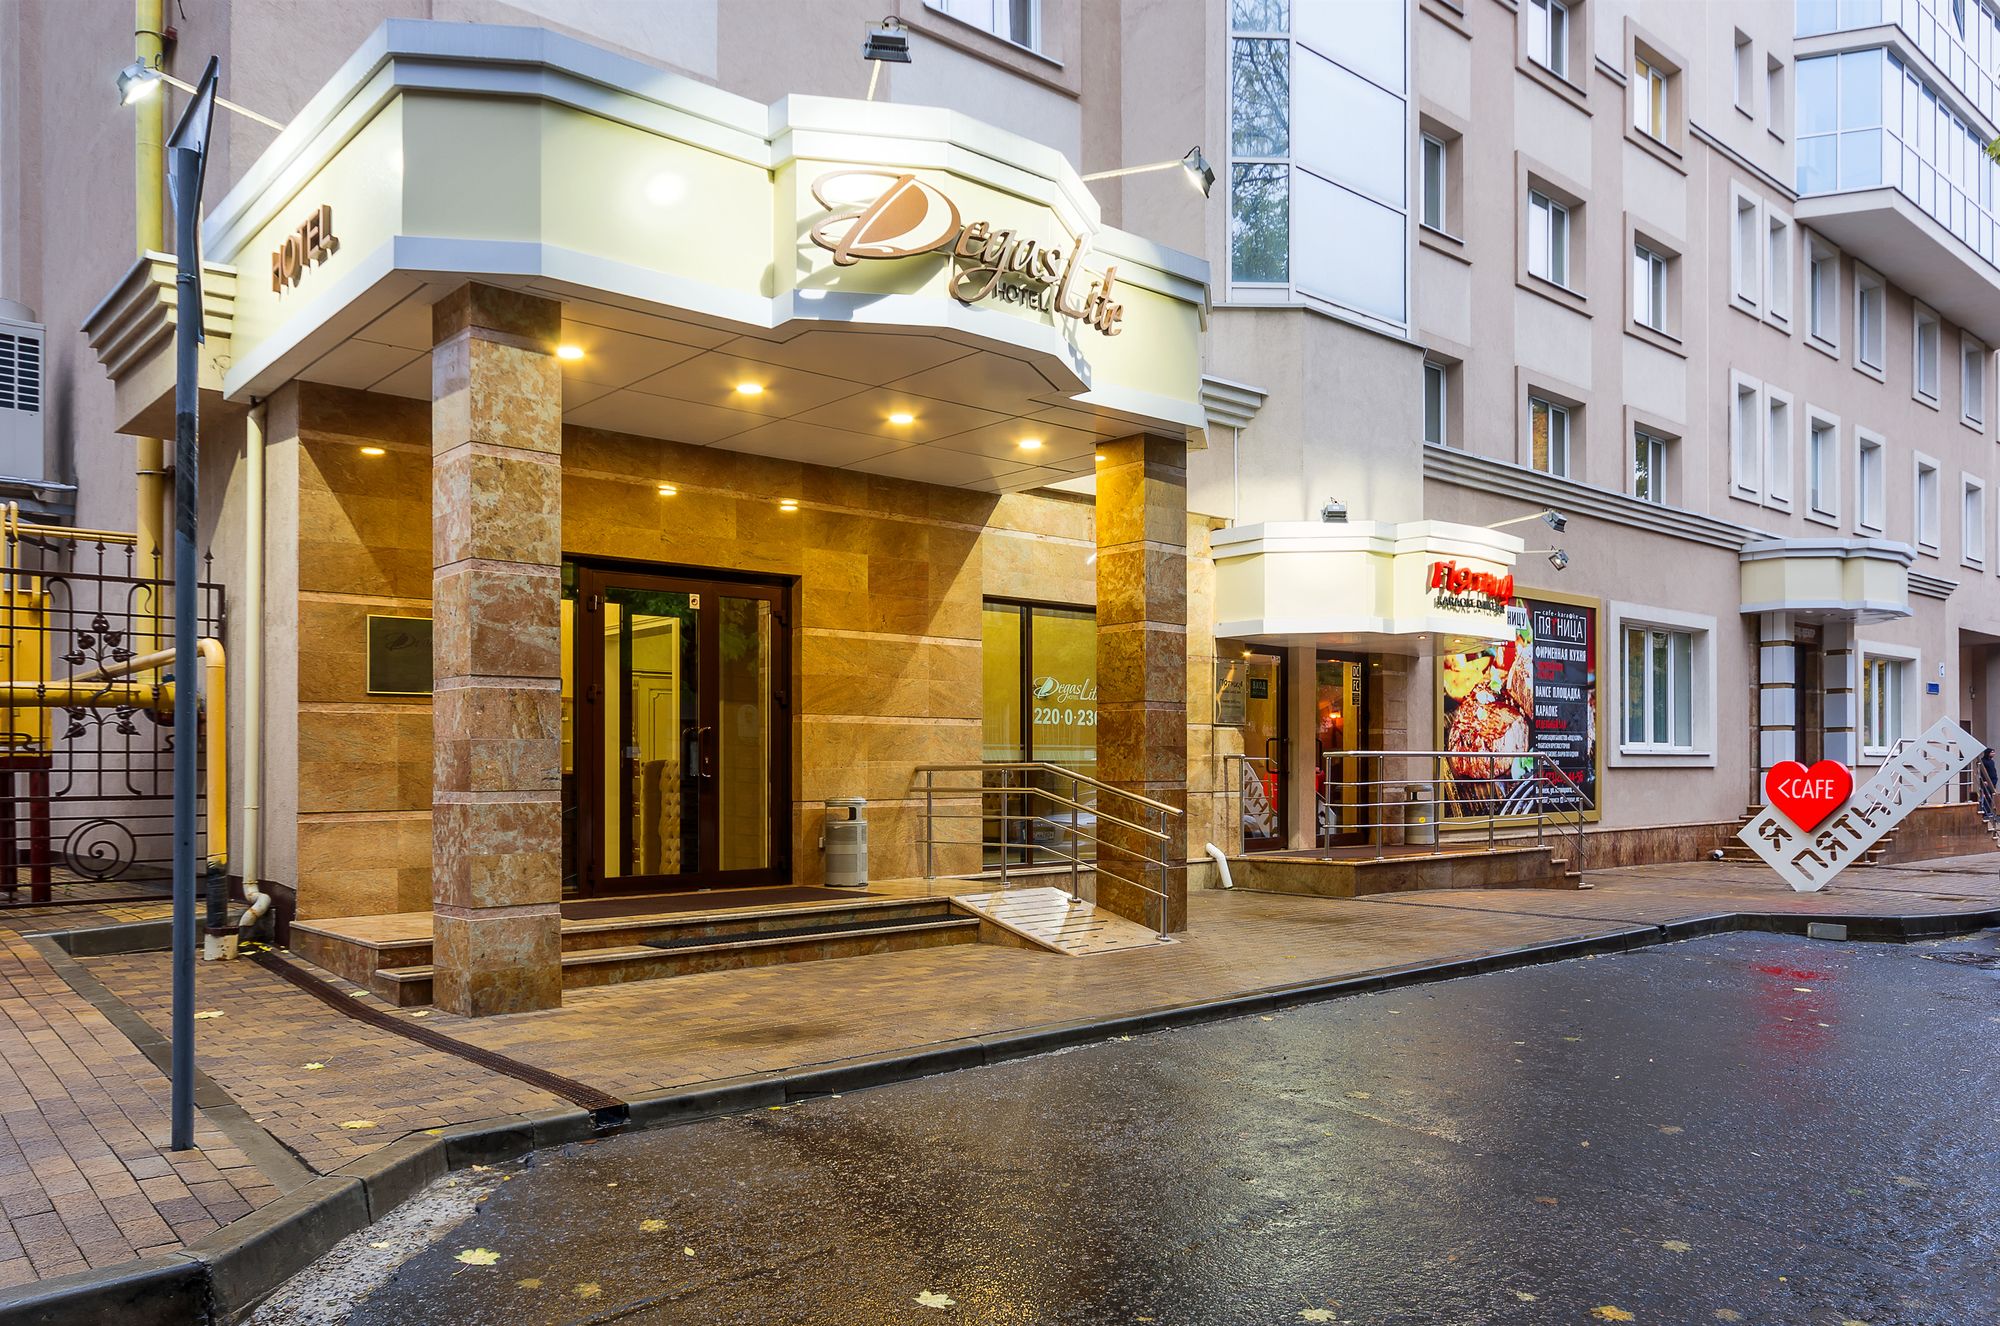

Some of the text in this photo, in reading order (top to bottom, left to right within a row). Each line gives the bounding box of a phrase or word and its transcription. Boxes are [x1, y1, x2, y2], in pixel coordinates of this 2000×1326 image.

[272, 204, 339, 293] HOTEL
[991, 282, 1049, 313] HOTEL
[1507, 611, 1526, 629] НИЦУ
[1538, 615, 1584, 642] ПЯТНИЦА
[1535, 645, 1587, 662] ФИРМЕННАЯ КУХНЯ
[1535, 685, 1581, 701] DANCE ПЛОЩАДКА
[1535, 704, 1558, 717] КАРАОКЕ
[1791, 778, 1834, 800] CAFE
[1757, 817, 1793, 852] Я
